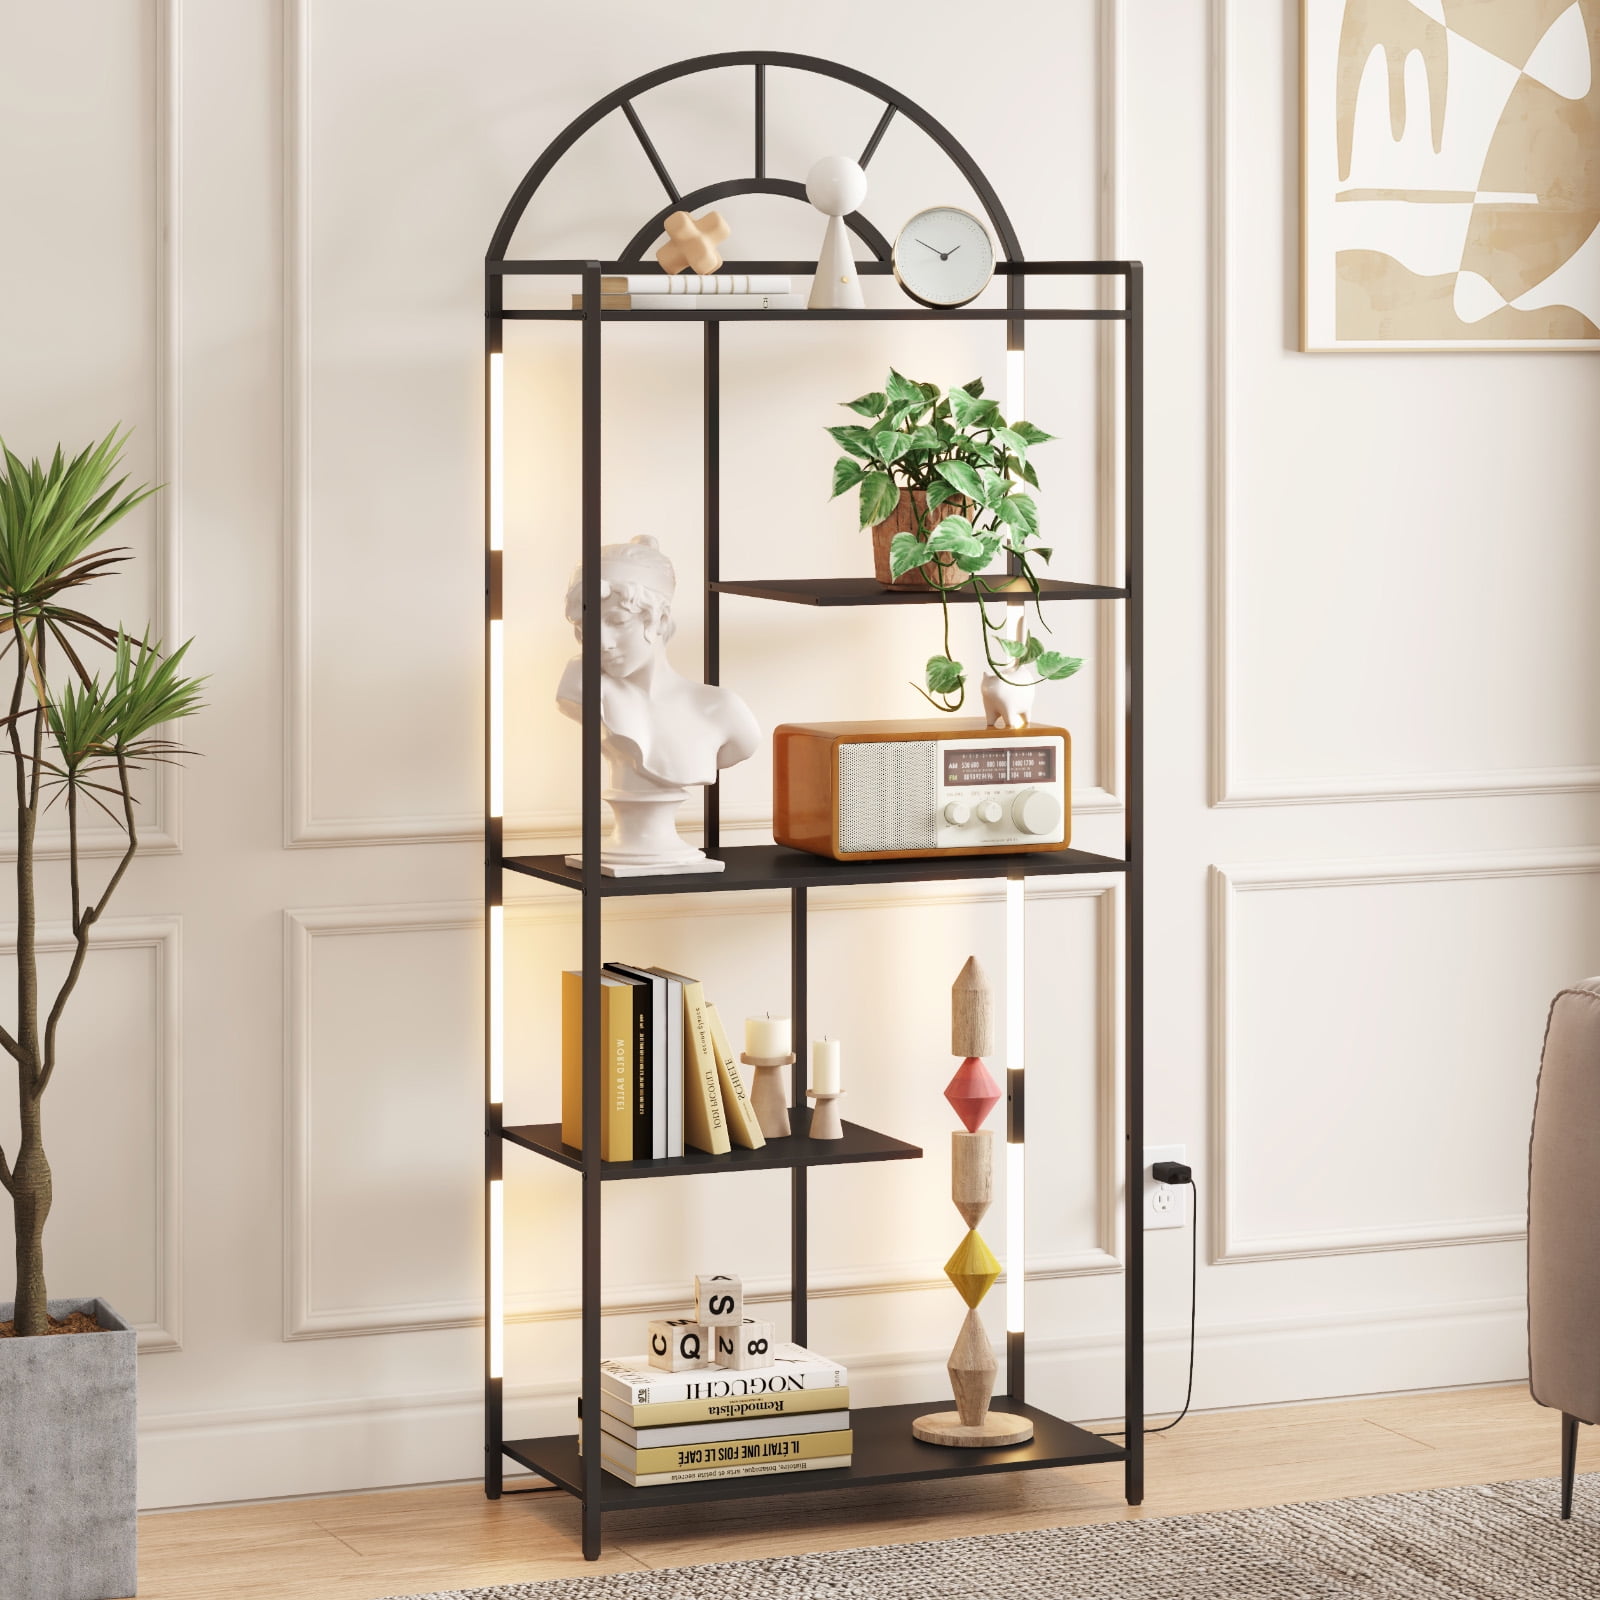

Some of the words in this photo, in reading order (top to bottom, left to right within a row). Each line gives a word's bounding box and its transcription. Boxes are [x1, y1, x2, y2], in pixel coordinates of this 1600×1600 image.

[708, 1294, 735, 1315] S
[652, 1333, 667, 1356] C
[680, 1333, 701, 1360] Q
[719, 1335, 734, 1355] 2
[747, 1338, 768, 1356] 8
[686, 1373, 805, 1400] NOGUCHI
[708, 1400, 784, 1416] Remodelista
[705, 1448, 716, 1462] LE
[718, 1446, 739, 1461] FOIS
[741, 1444, 760, 1459] UNE
[762, 1441, 789, 1458] ÉTAIT
[792, 1440, 800, 1454] IL
[678, 1449, 702, 1468] CAFÉ
